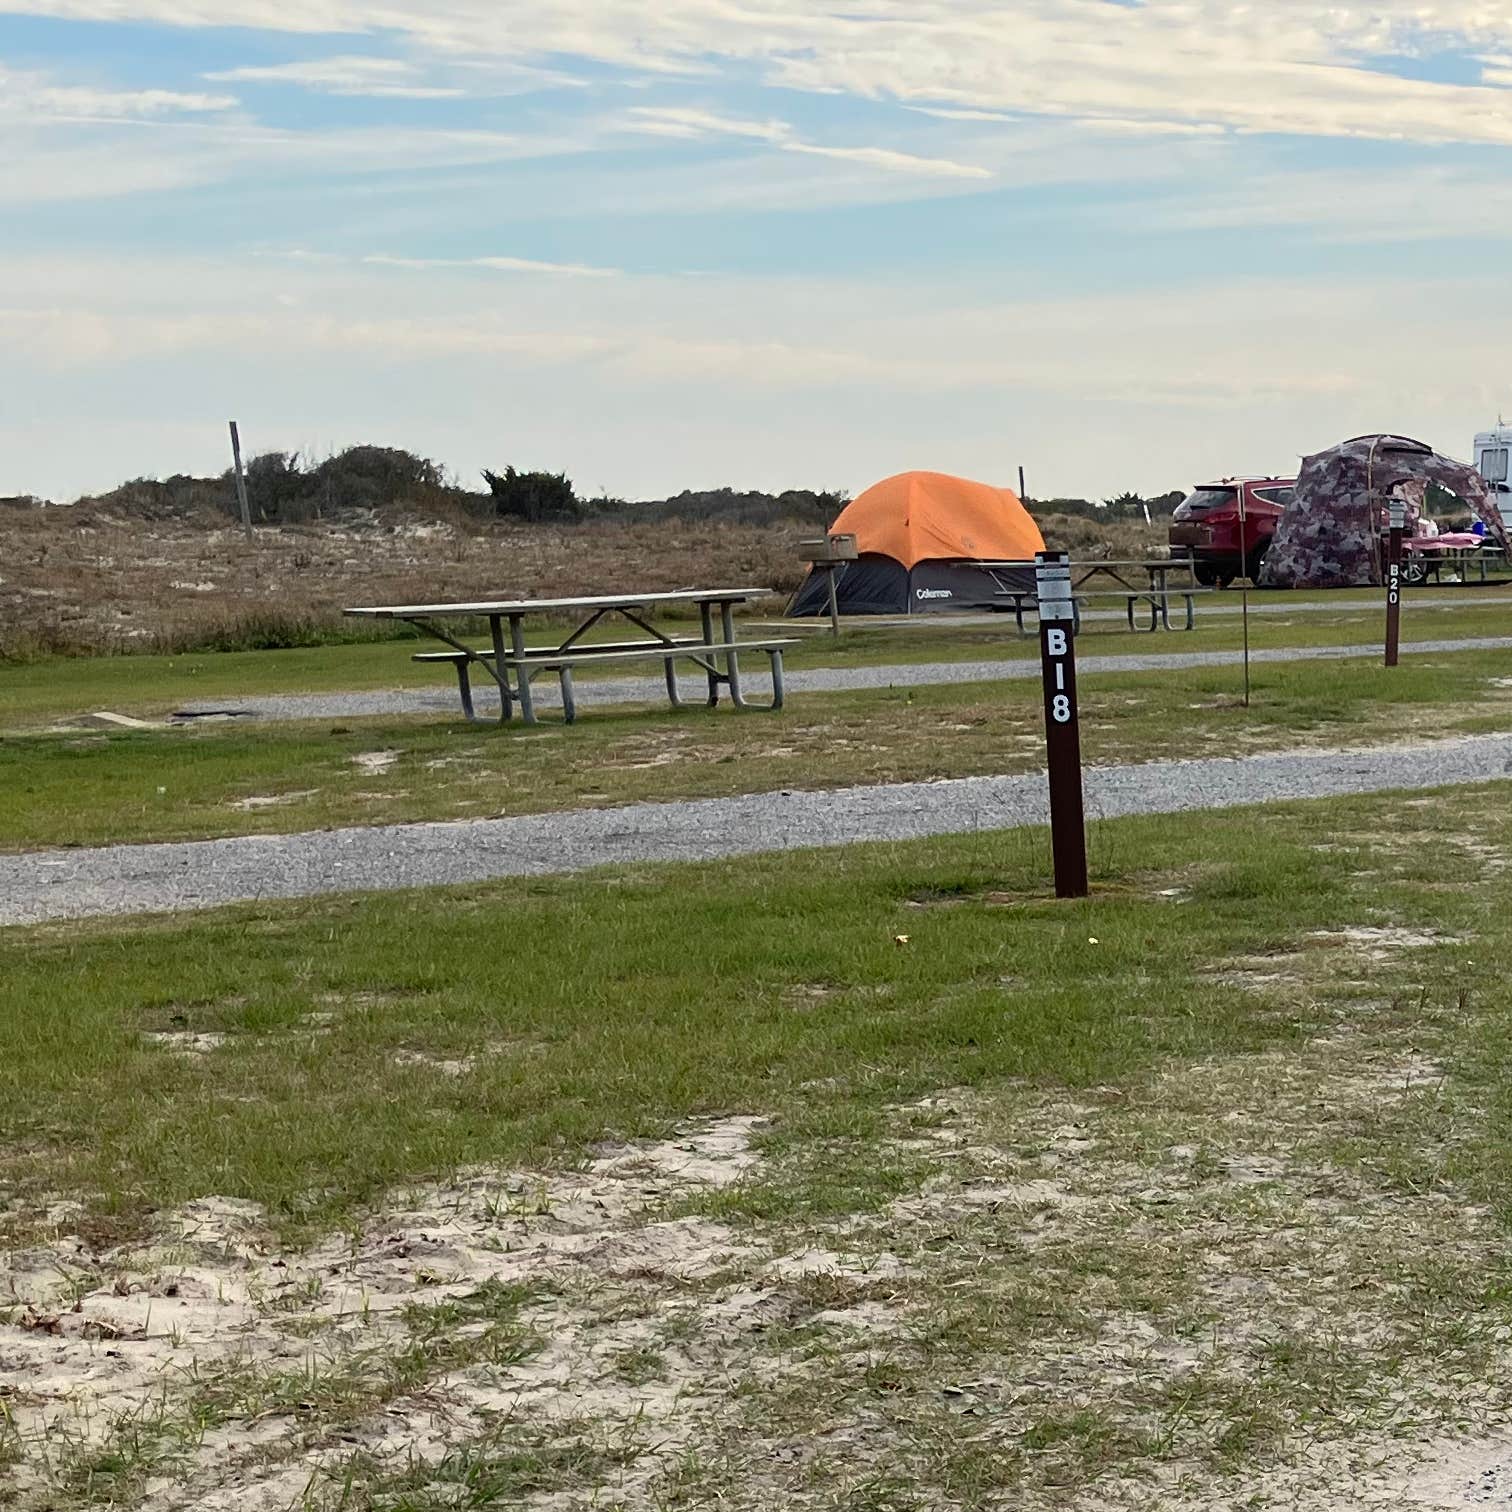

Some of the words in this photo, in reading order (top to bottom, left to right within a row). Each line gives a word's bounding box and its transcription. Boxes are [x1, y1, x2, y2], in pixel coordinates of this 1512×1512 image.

[916, 588, 952, 599] Coleman
[1389, 564, 1399, 604] B20
[1047, 628, 1071, 723] B18
